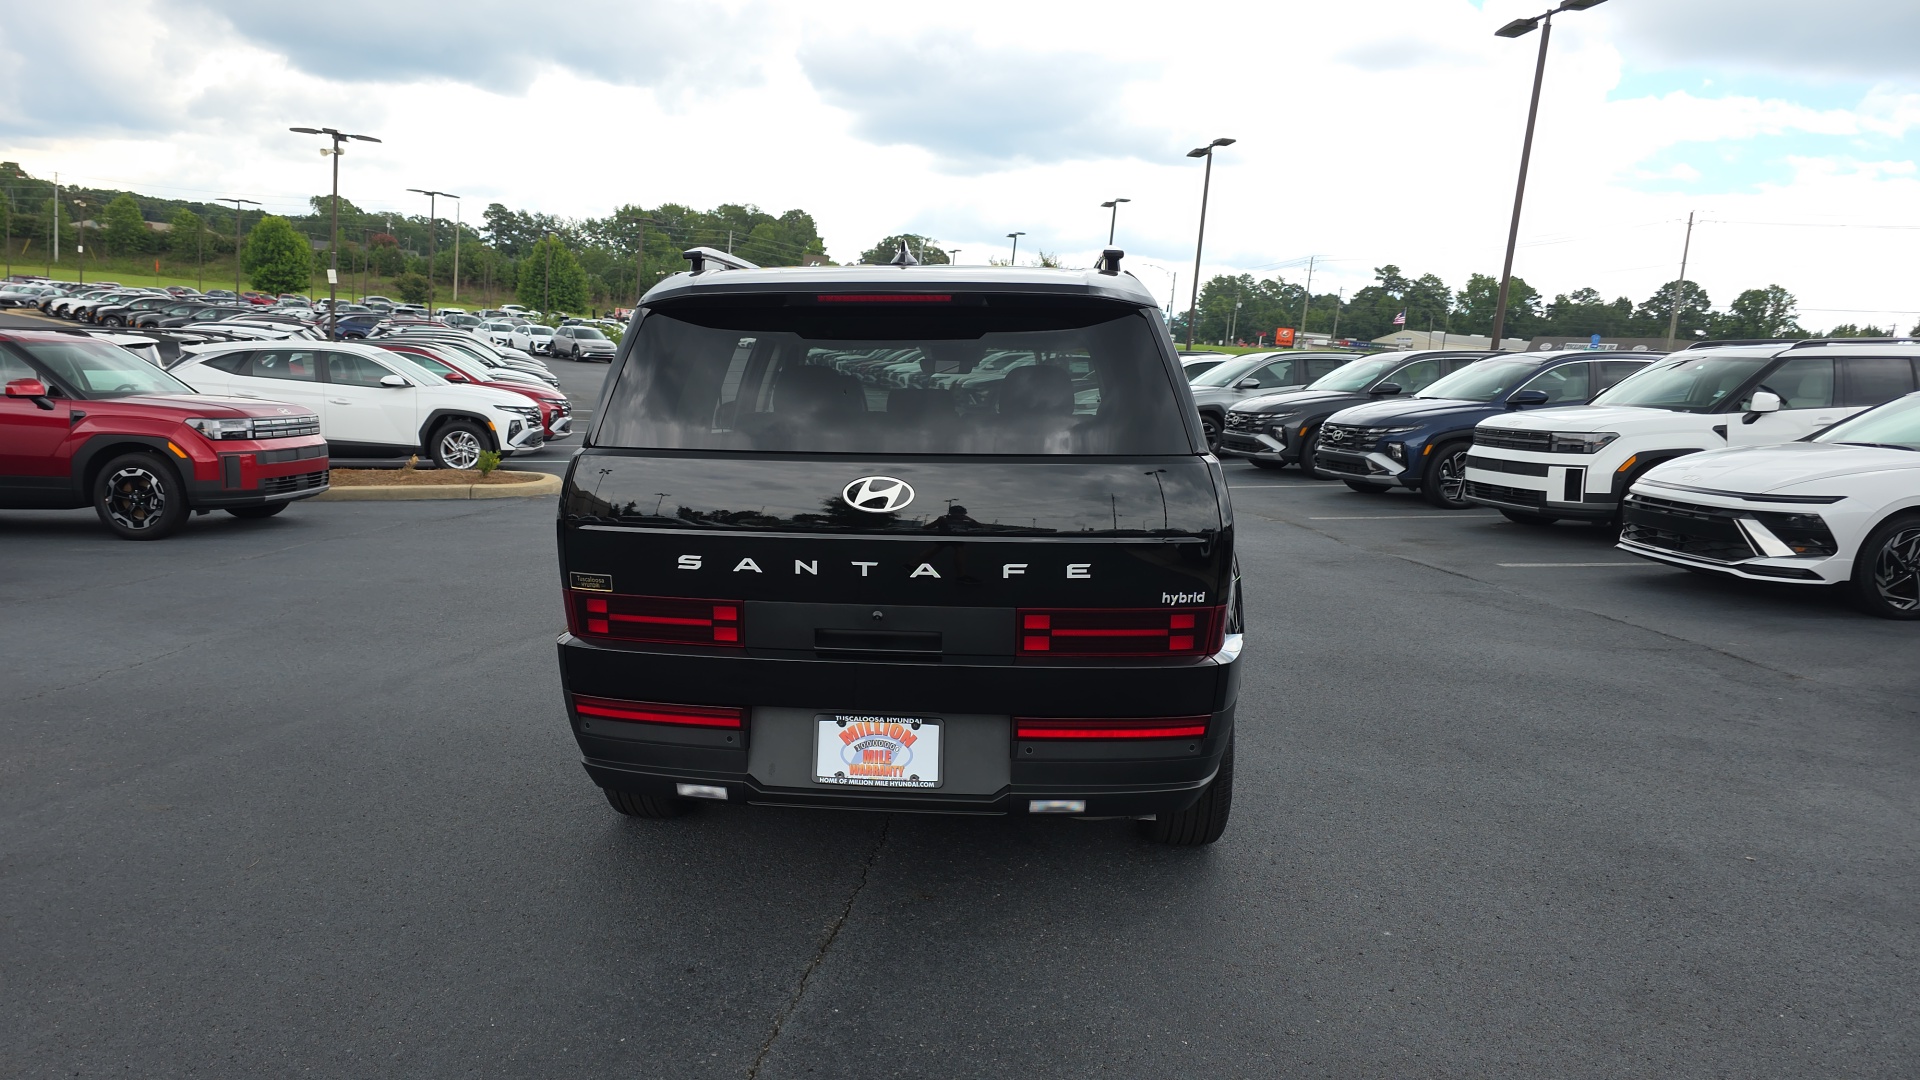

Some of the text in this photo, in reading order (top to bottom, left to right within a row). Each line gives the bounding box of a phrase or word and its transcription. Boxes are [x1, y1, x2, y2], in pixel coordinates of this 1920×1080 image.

[677, 554, 1092, 579] SANTA FE
[1161, 591, 1206, 606] hybrid
[835, 715, 923, 725] TUSCALOOSA HYUNDAI
[838, 721, 918, 748] MILLION
[862, 749, 892, 765] MILE
[849, 763, 905, 777] WARRANTY
[889, 780, 935, 788] HYUNDAI.COM
